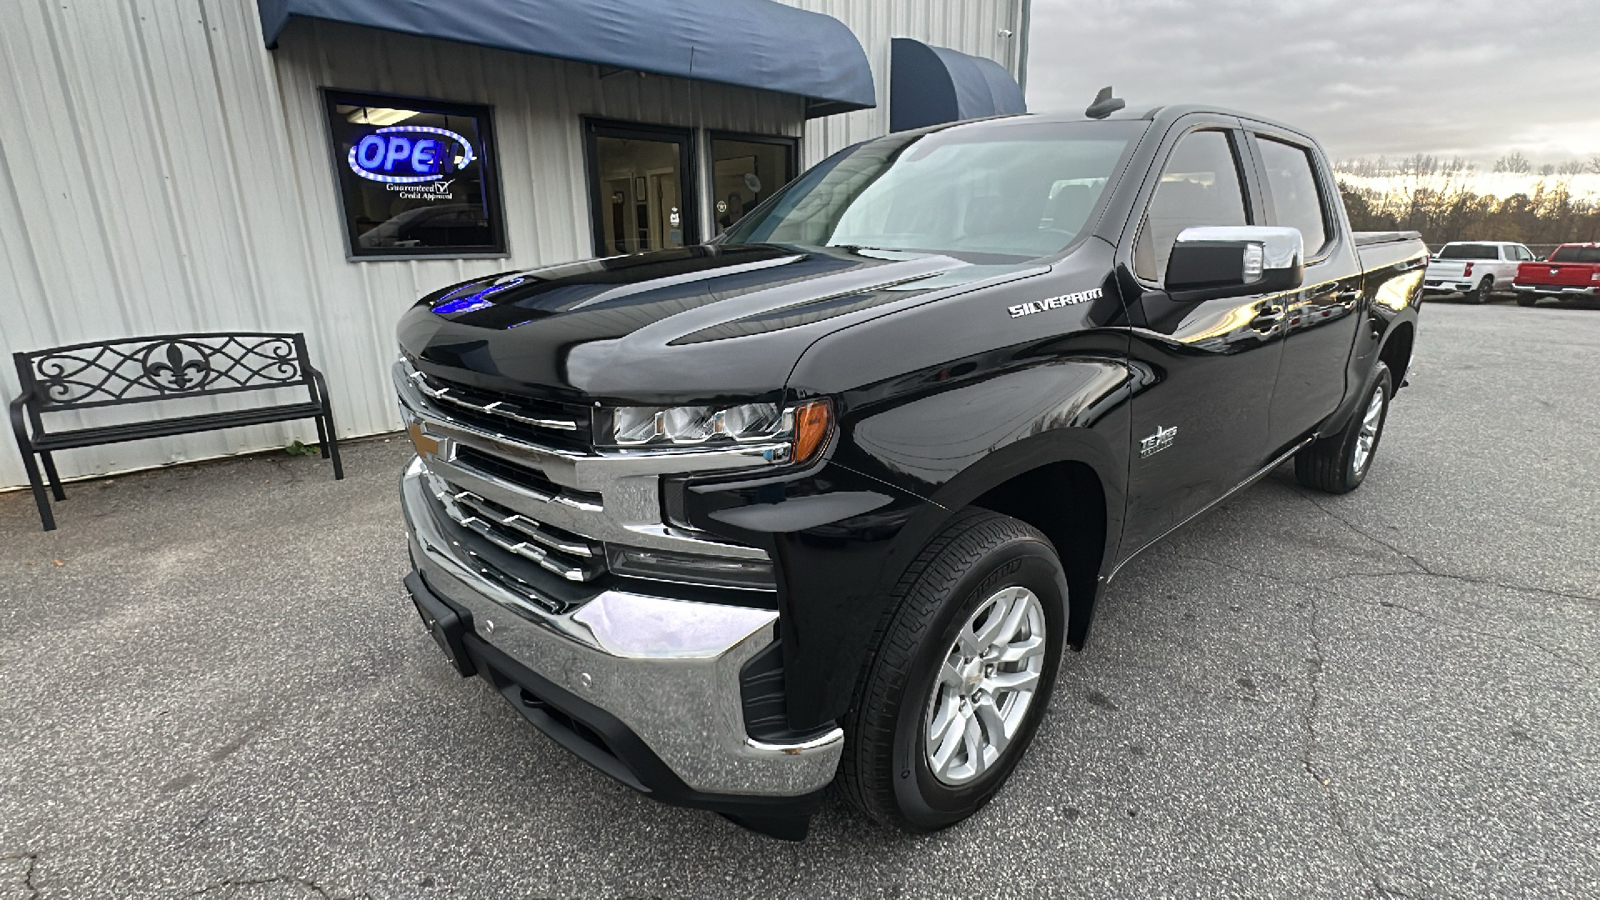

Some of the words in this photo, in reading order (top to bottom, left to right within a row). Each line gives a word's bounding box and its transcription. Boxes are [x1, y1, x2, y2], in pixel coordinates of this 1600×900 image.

[357, 134, 459, 174] OPEN
[386, 182, 435, 193] Guaranteed
[399, 191, 421, 199] Credit
[422, 192, 453, 202] Approval
[1007, 287, 1103, 319] SILVERADO
